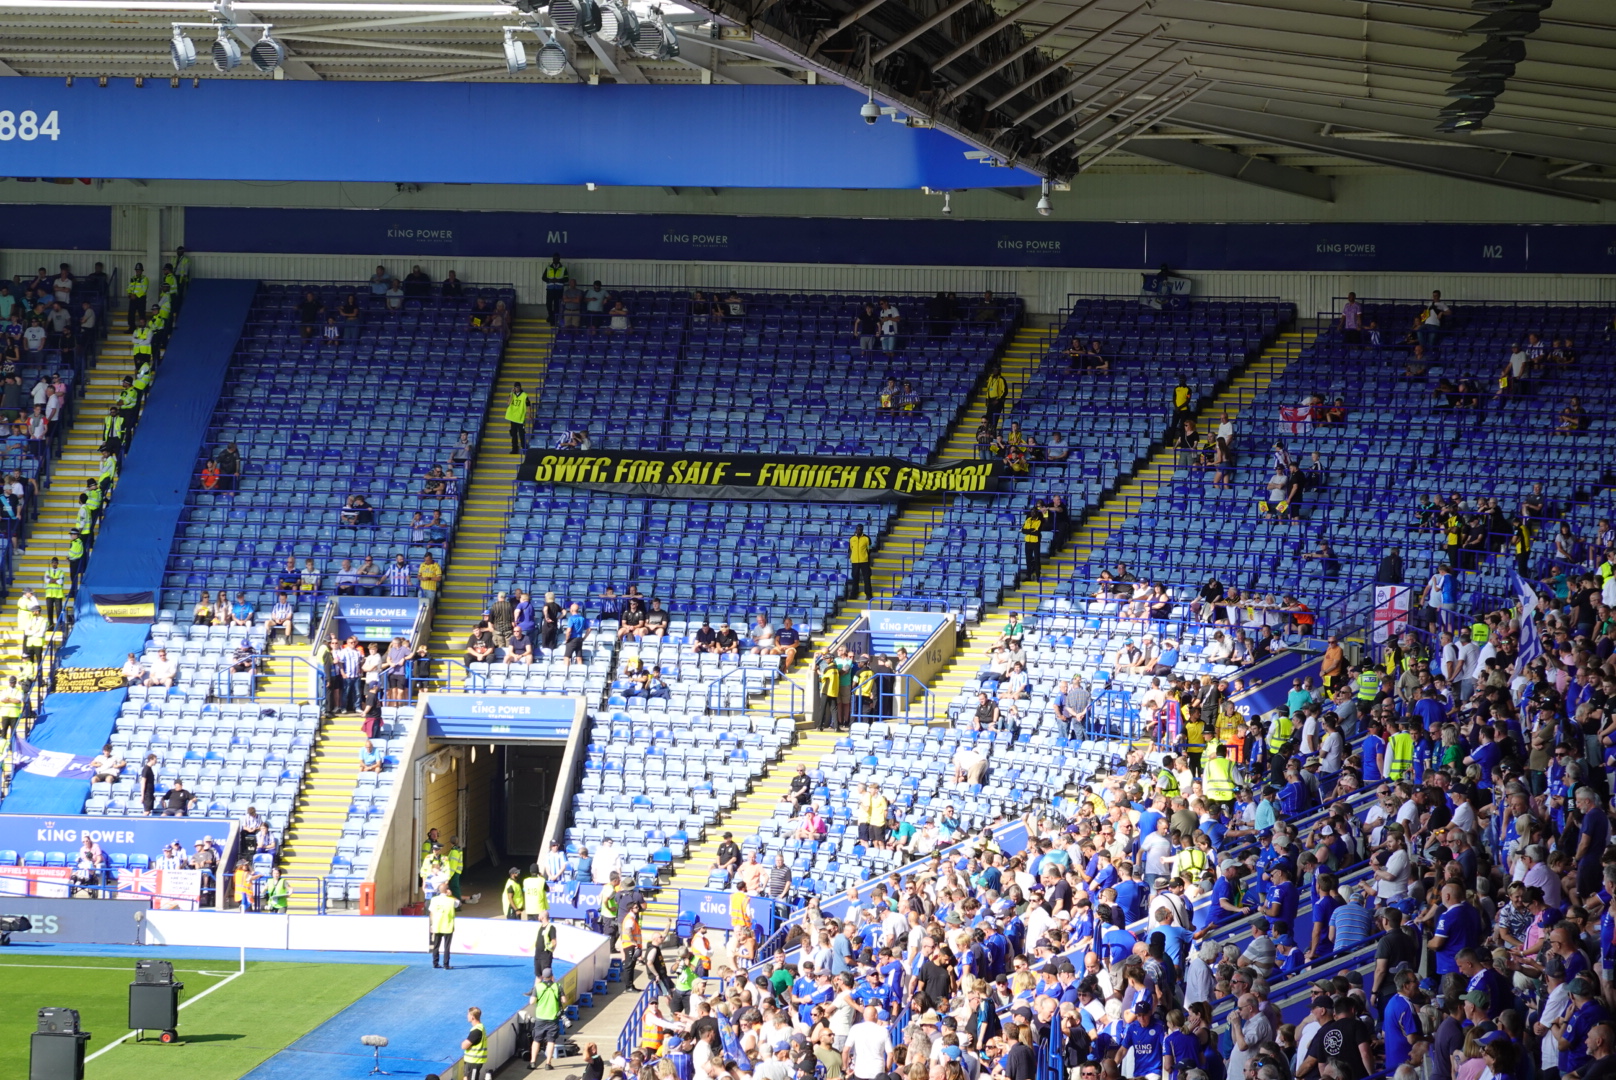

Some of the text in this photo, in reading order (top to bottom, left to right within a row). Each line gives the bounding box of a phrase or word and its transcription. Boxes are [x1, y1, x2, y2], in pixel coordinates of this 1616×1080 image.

[0, 110, 61, 141] 884
[387, 229, 453, 239] KING POWER
[546, 230, 568, 244] M1
[663, 234, 728, 244] KING POWER
[997, 240, 1061, 250] KING POWER
[1316, 243, 1376, 253] KING POWER
[1482, 245, 1503, 259] M2
[535, 455, 612, 483] SWFC
[613, 459, 665, 483] FOR
[757, 463, 861, 488] ENOUGH
[863, 466, 891, 489] IS
[130, 607, 140, 615] OUT
[349, 608, 407, 616] KING POWER
[880, 622, 933, 633] KING POWER
[926, 649, 942, 664] V43
[68, 671, 94, 680] TOXIC
[471, 705, 531, 714] KING POWER
[37, 828, 135, 844] KING POWER
[700, 902, 727, 915] KING
